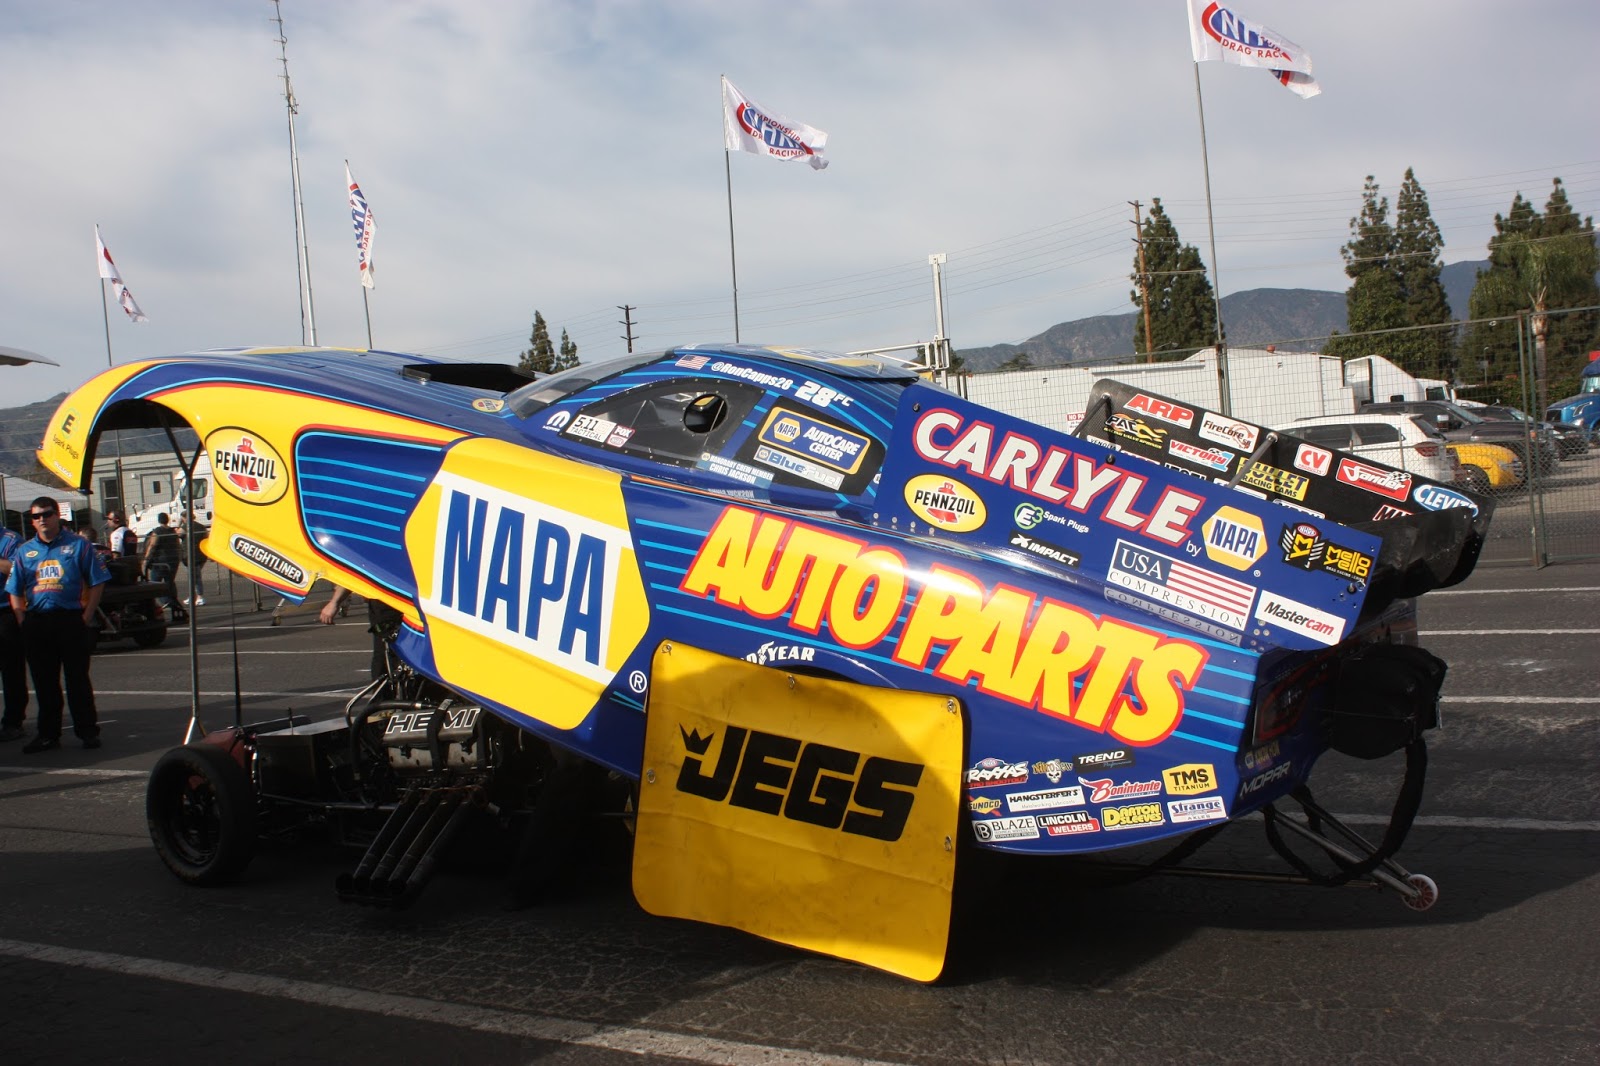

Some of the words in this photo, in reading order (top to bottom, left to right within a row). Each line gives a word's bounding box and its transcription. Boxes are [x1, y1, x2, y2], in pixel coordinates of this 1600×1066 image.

[1222, 38, 1252, 56] DRAG
[1257, 49, 1283, 59] RAC
[769, 147, 805, 157] RACING
[711, 362, 794, 390] @RonCapps28
[1127, 395, 1194, 422] ARP
[570, 427, 602, 441] TACTICAL
[574, 417, 599, 431] 5.11
[614, 426, 632, 438] FOX
[777, 422, 798, 438] NAPA
[1105, 416, 1141, 435] PAC
[809, 442, 844, 461] CENTER
[1171, 440, 1228, 465] VICTORY
[1301, 450, 1327, 469] CV
[215, 450, 277, 480] PENNZOIL
[709, 463, 730, 476] CHRIS
[728, 469, 757, 485] JACKSON
[736, 461, 752, 474] CREW
[751, 467, 775, 480] MEMBER
[914, 410, 1204, 545] CARLYLE
[1243, 475, 1272, 489] RACING
[1274, 485, 1298, 498] CAMS
[914, 490, 976, 516] PENNZOIL
[1043, 510, 1066, 528] Spark
[1066, 518, 1090, 534] Plugs
[1186, 540, 1202, 557] by
[1210, 519, 1259, 560] NAPA
[236, 539, 303, 583] FREIGHTLINER
[1028, 541, 1079, 567] IMPACT
[1121, 547, 1163, 581] USA
[40, 565, 60, 579] NAPA
[440, 489, 607, 667] NAPA
[1109, 571, 1245, 630] COMPRESSION
[679, 505, 909, 651] AUTO
[892, 562, 1210, 748] PARTS
[1264, 601, 1335, 636] Mastercam
[386, 708, 482, 735] HEMI
[1078, 750, 1125, 765] TREND
[676, 724, 925, 843] JEGS
[1170, 768, 1209, 786] TMS
[1174, 783, 1210, 792] TITANIUM
[1240, 761, 1291, 798] MOPAR
[1009, 788, 1080, 803] HANGSTERFER'S
[1082, 778, 1161, 803] Boninfante
[968, 800, 1001, 810] SUNOCO
[1104, 803, 1161, 827] DARTON
[1172, 800, 1221, 814] Strange
[991, 818, 1035, 831] BLAZE
[1040, 814, 1087, 826] LINCOLN
[1053, 824, 1094, 834] WELDERS
